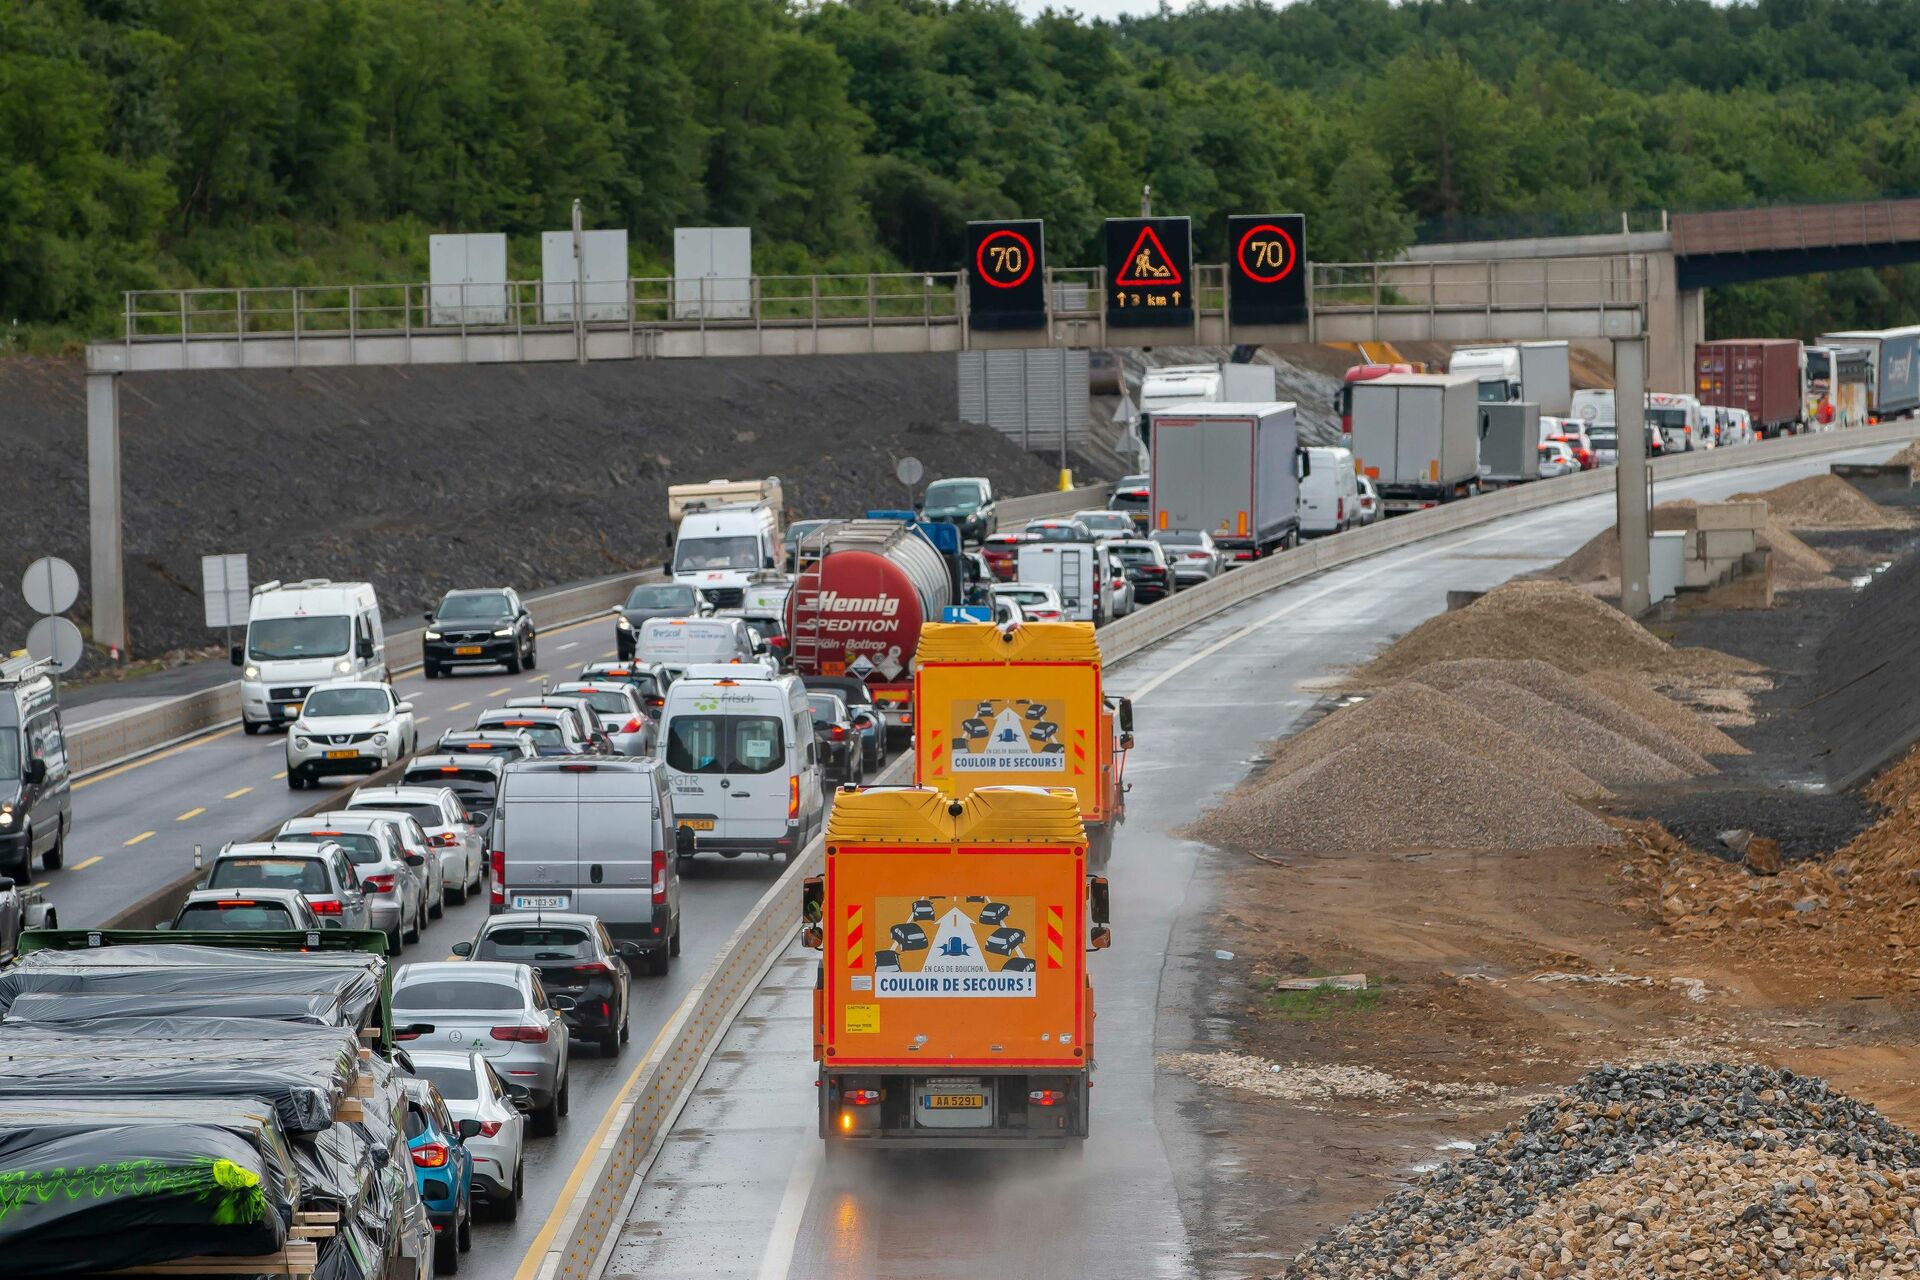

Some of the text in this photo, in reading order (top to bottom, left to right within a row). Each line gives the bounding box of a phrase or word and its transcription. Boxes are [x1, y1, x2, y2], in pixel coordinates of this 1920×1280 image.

[990, 246, 1022, 273] 70
[1251, 241, 1283, 268] 70
[1131, 293, 1167, 306] 3 km
[805, 590, 900, 616] Hennig
[806, 618, 899, 632] SPEDITION
[846, 639, 887, 650] Bottrop
[721, 692, 754, 703] Frisch
[954, 757, 996, 768] COULOIR
[999, 757, 1011, 768] DE
[1014, 757, 1057, 768] SECOURS
[665, 775, 699, 786] RGTR
[880, 977, 939, 991] COULOIR
[943, 977, 959, 991] DE
[963, 977, 1024, 991] SECOURS
[936, 1096, 949, 1106] AA
[951, 1096, 977, 1106] 5291
